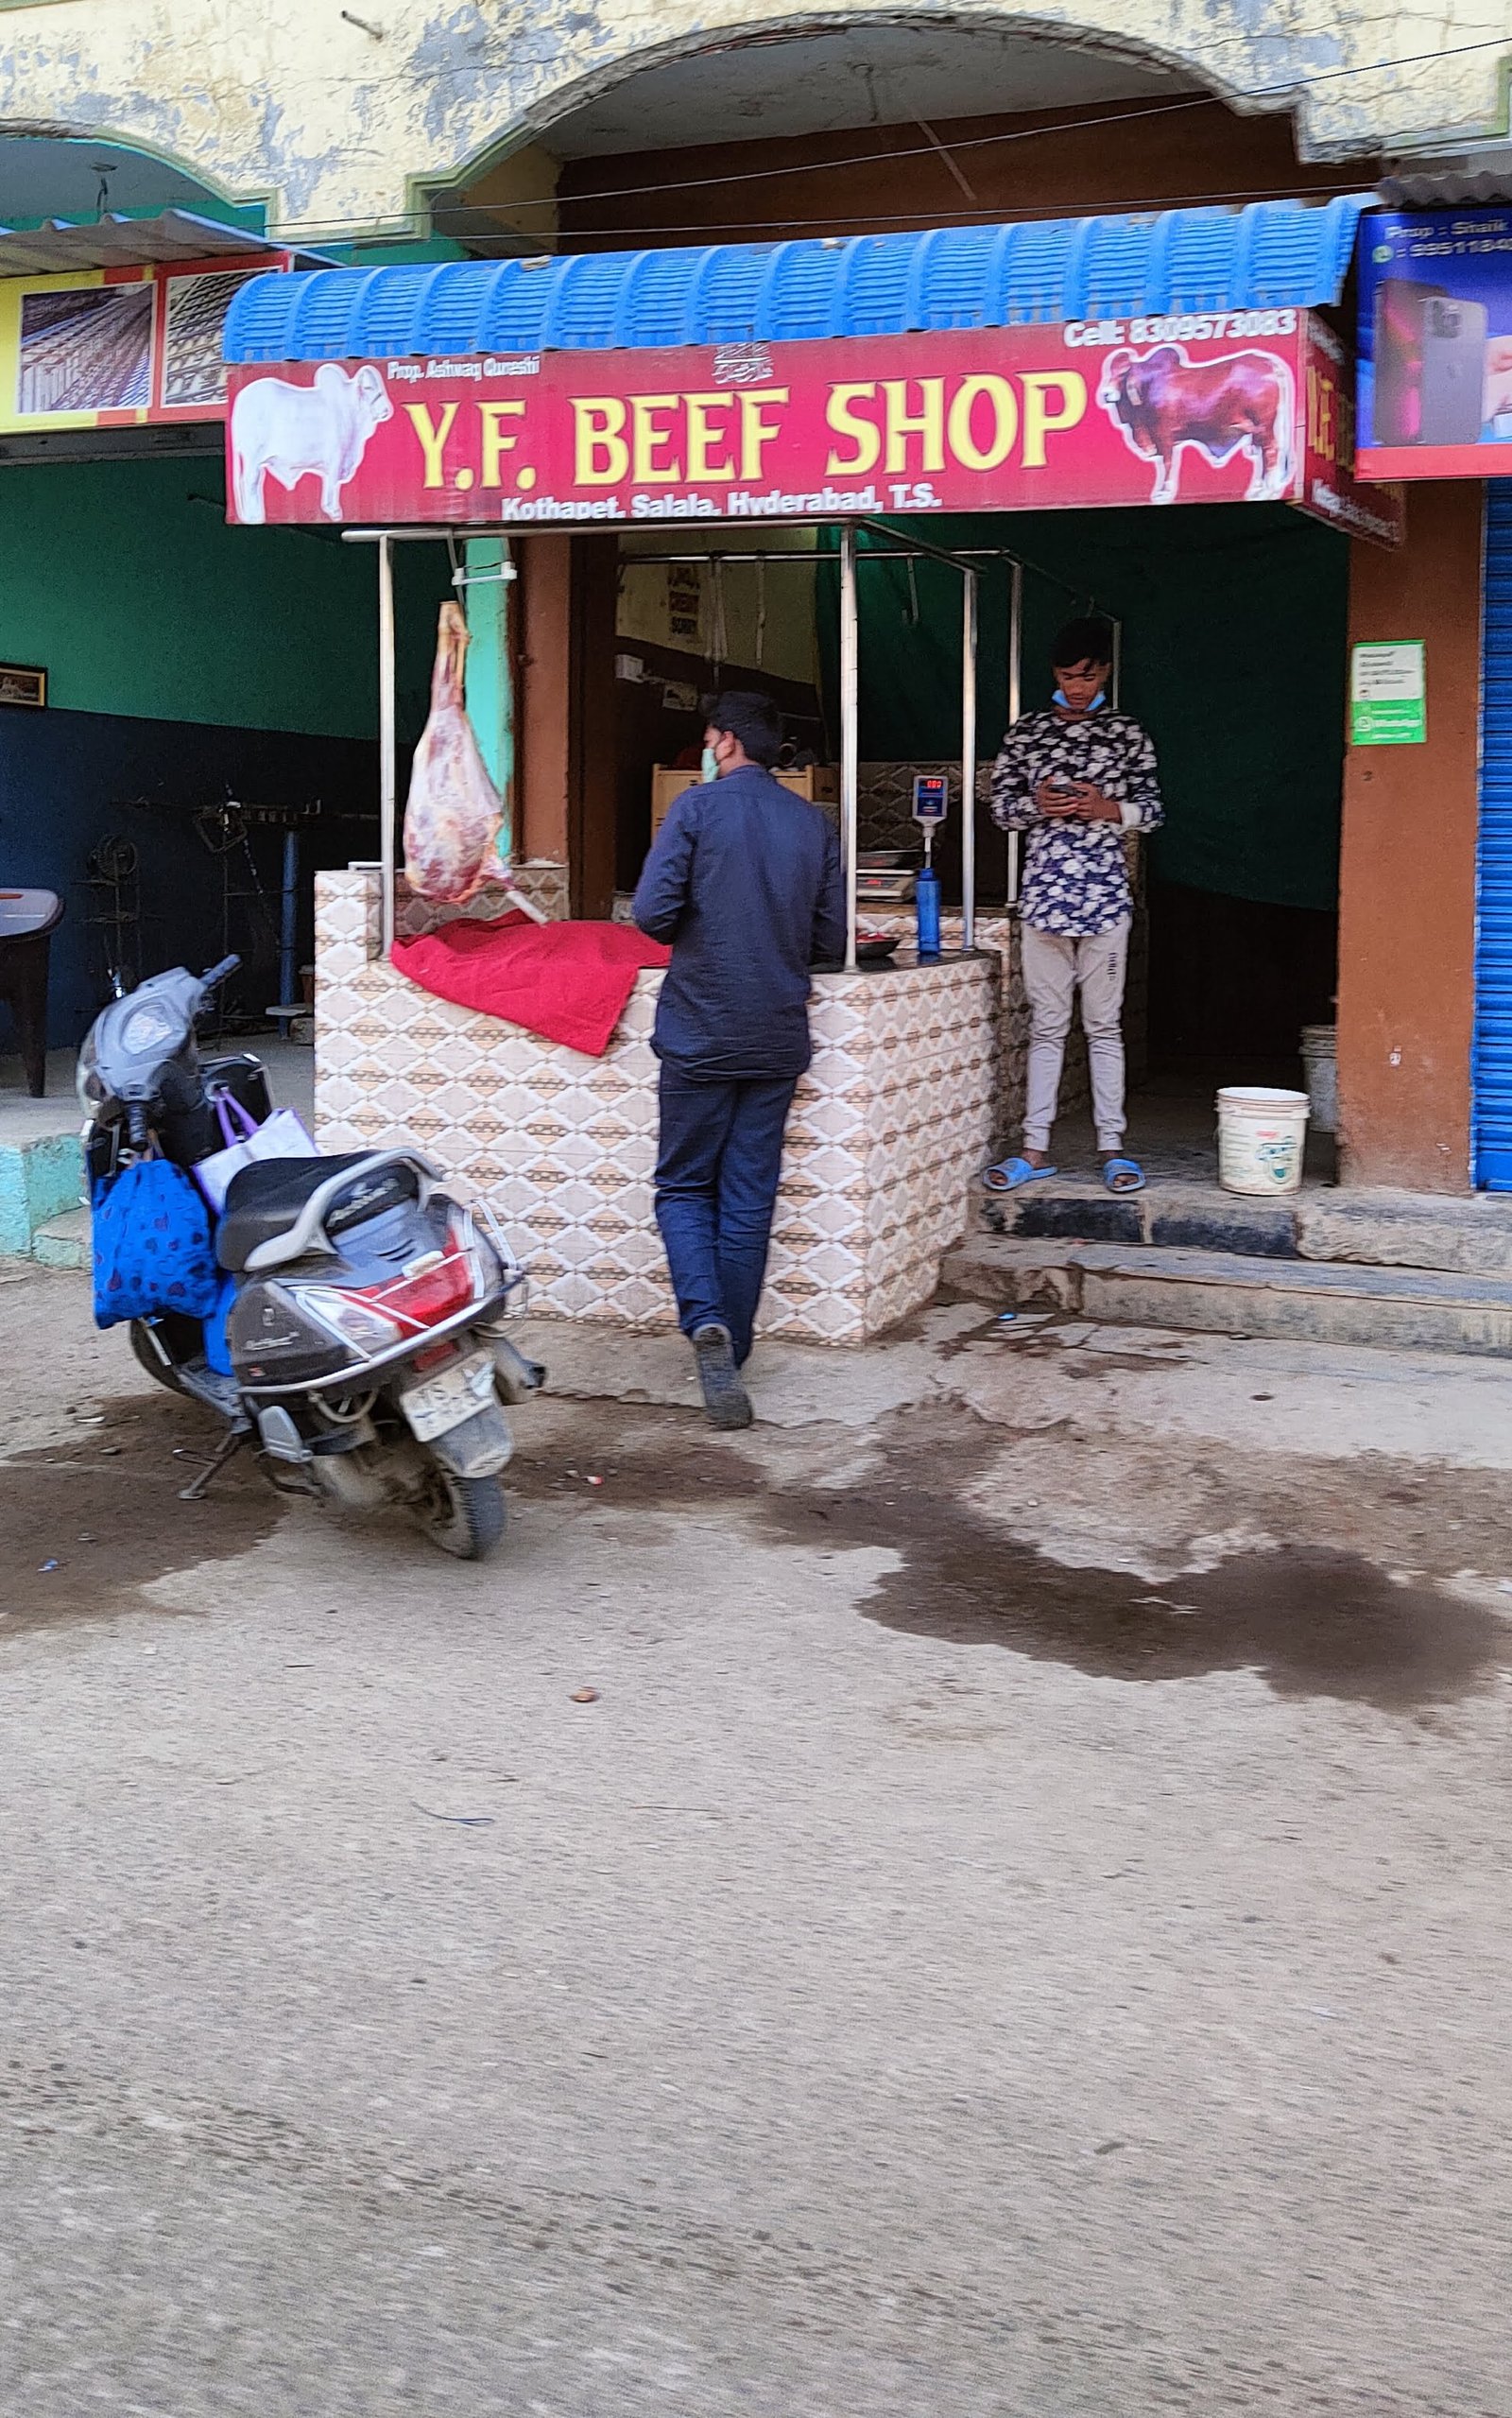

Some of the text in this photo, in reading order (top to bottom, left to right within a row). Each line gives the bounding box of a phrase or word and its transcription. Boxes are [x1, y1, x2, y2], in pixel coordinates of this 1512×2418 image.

[1063, 320, 1125, 348] Cell:
[1129, 308, 1297, 344] 8309573083
[401, 369, 1088, 491] Y.F. BEEF SHOP
[888, 482, 943, 509] T.S.
